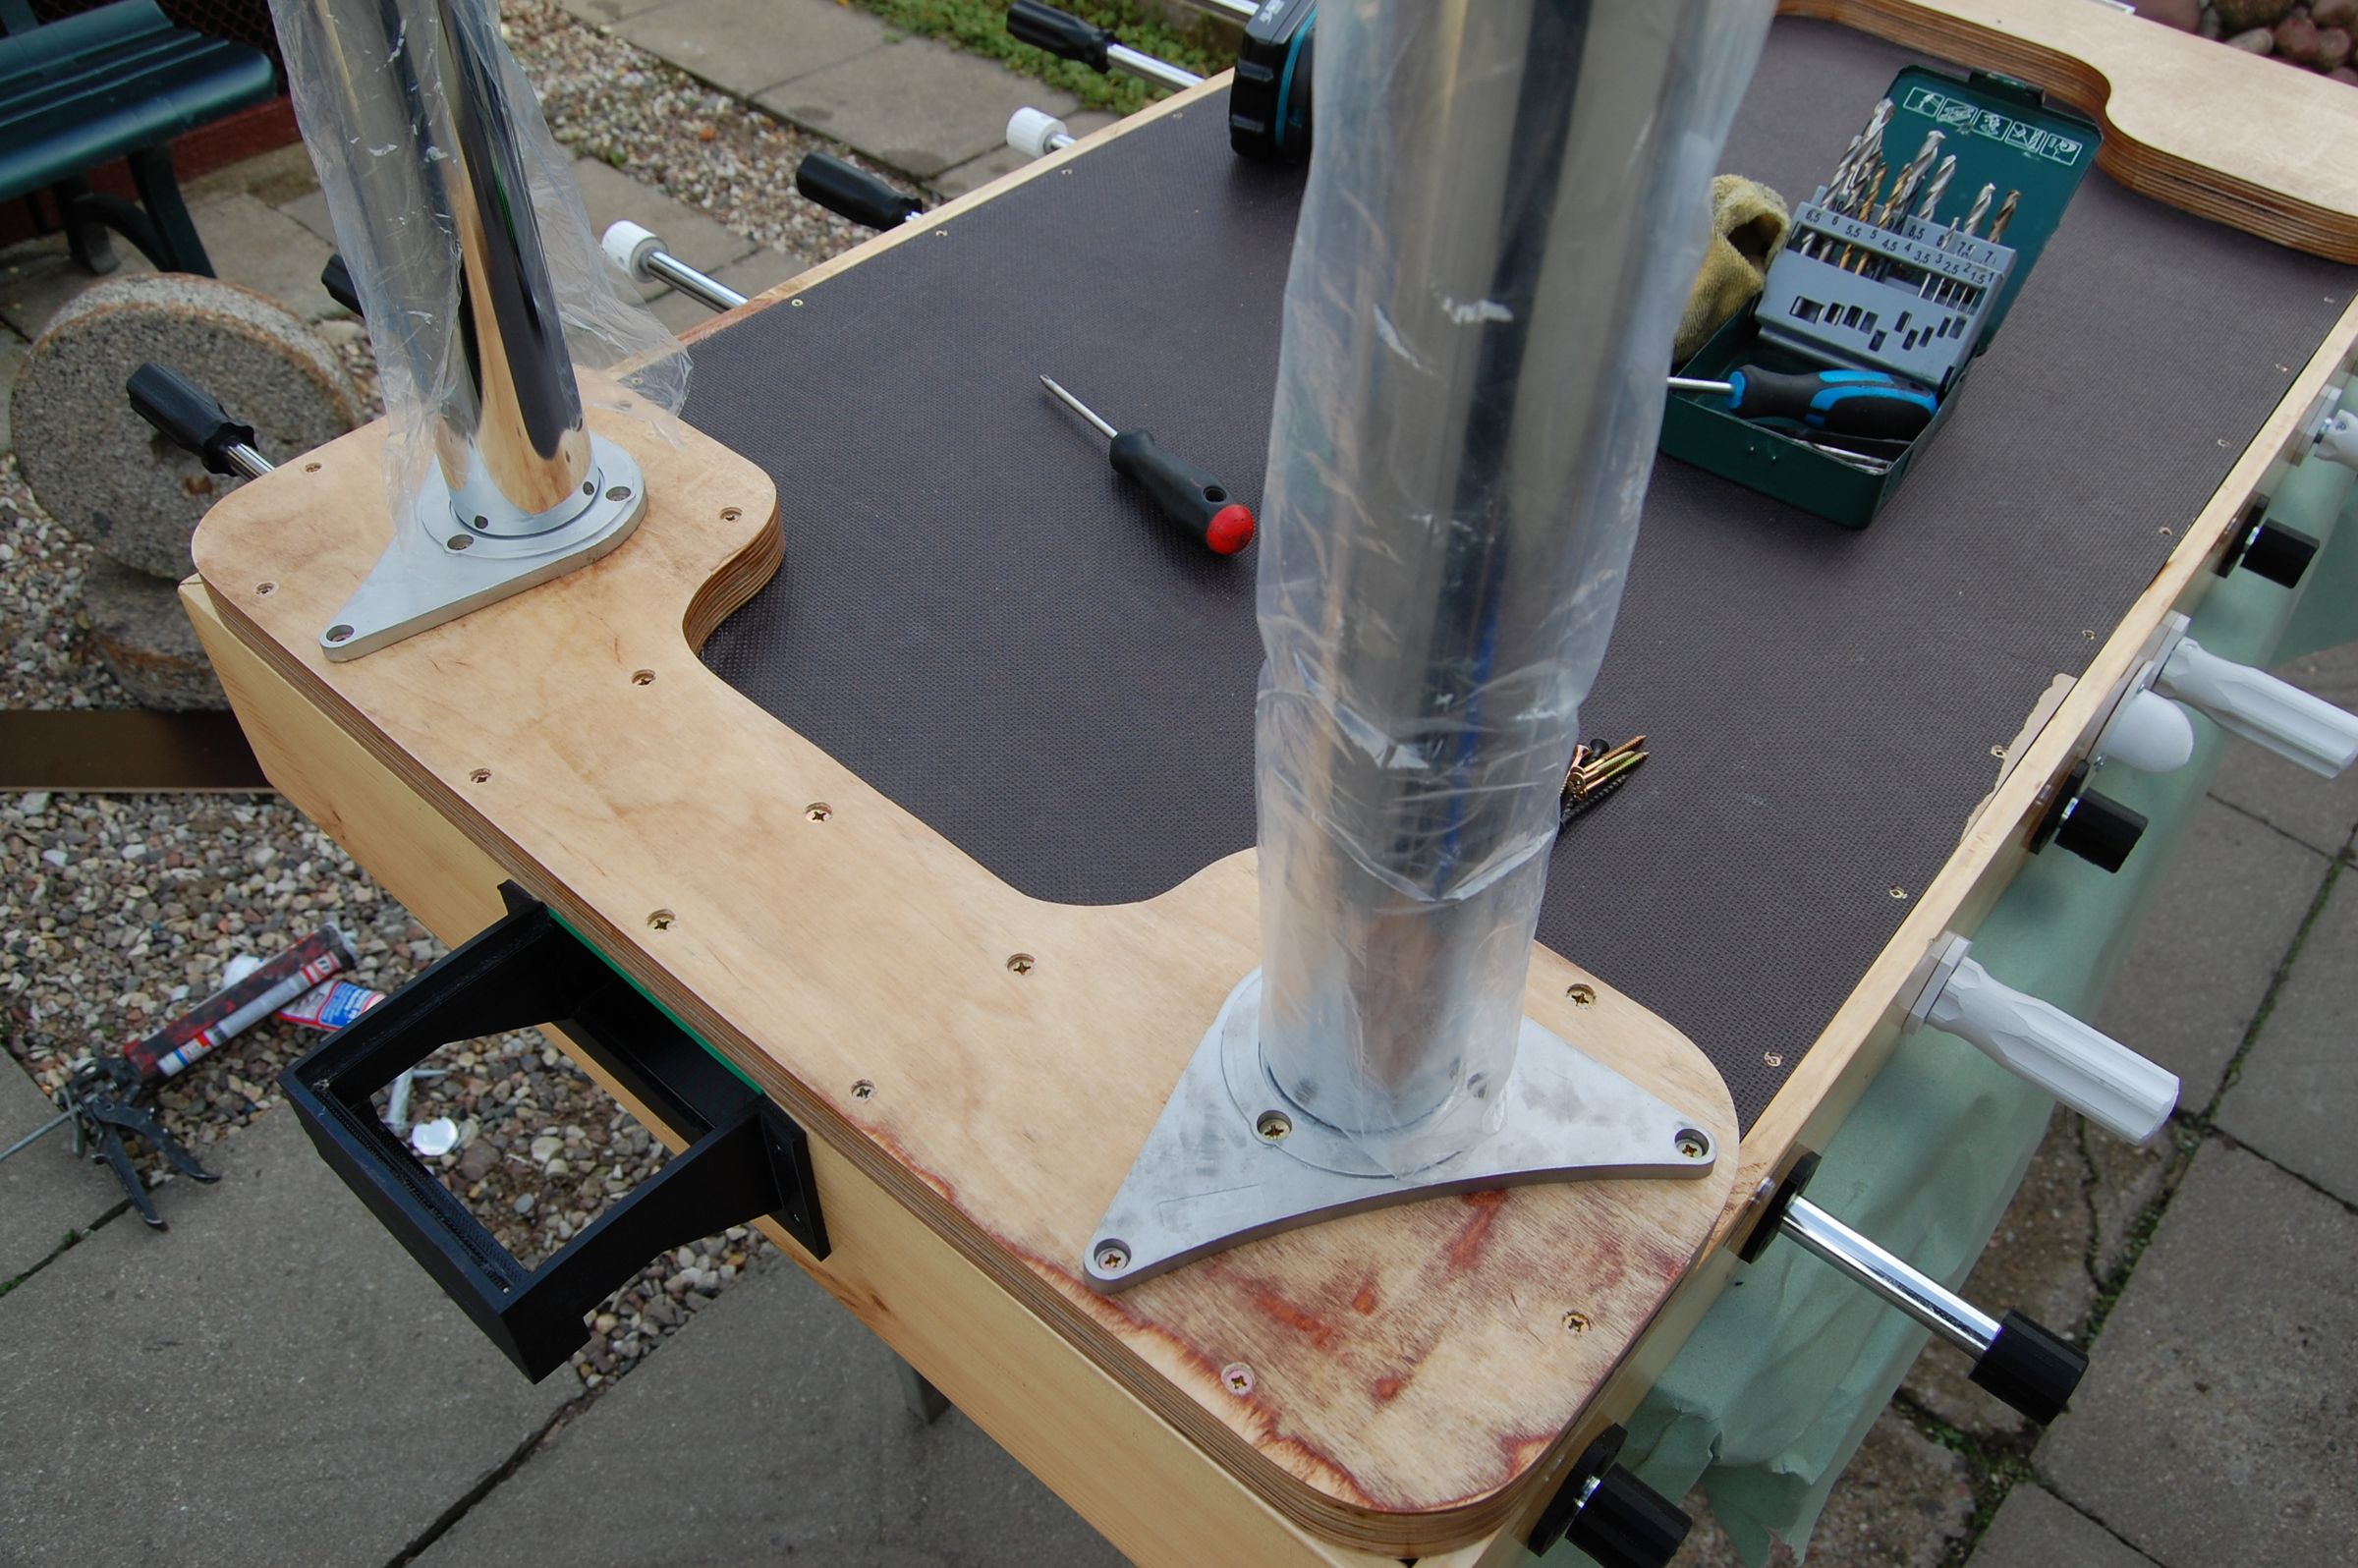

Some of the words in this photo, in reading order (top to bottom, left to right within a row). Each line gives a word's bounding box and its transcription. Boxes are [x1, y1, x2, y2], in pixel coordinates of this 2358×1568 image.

[1806, 208, 1822, 223] 6,5
[1831, 216, 1839, 226] 6
[1845, 225, 1862, 238] 5,5
[1870, 230, 1879, 240] 5
[1881, 239, 1898, 252] 4,5
[1904, 242, 1913, 252] 4
[1914, 251, 1932, 264] 3,5
[1935, 253, 1943, 264] 3
[1942, 261, 1959, 275] 2,5
[1963, 262, 1971, 274] 2
[1988, 271, 1995, 282] 1
[1909, 225, 1926, 241] 8,5
[1985, 251, 1993, 262] 7
